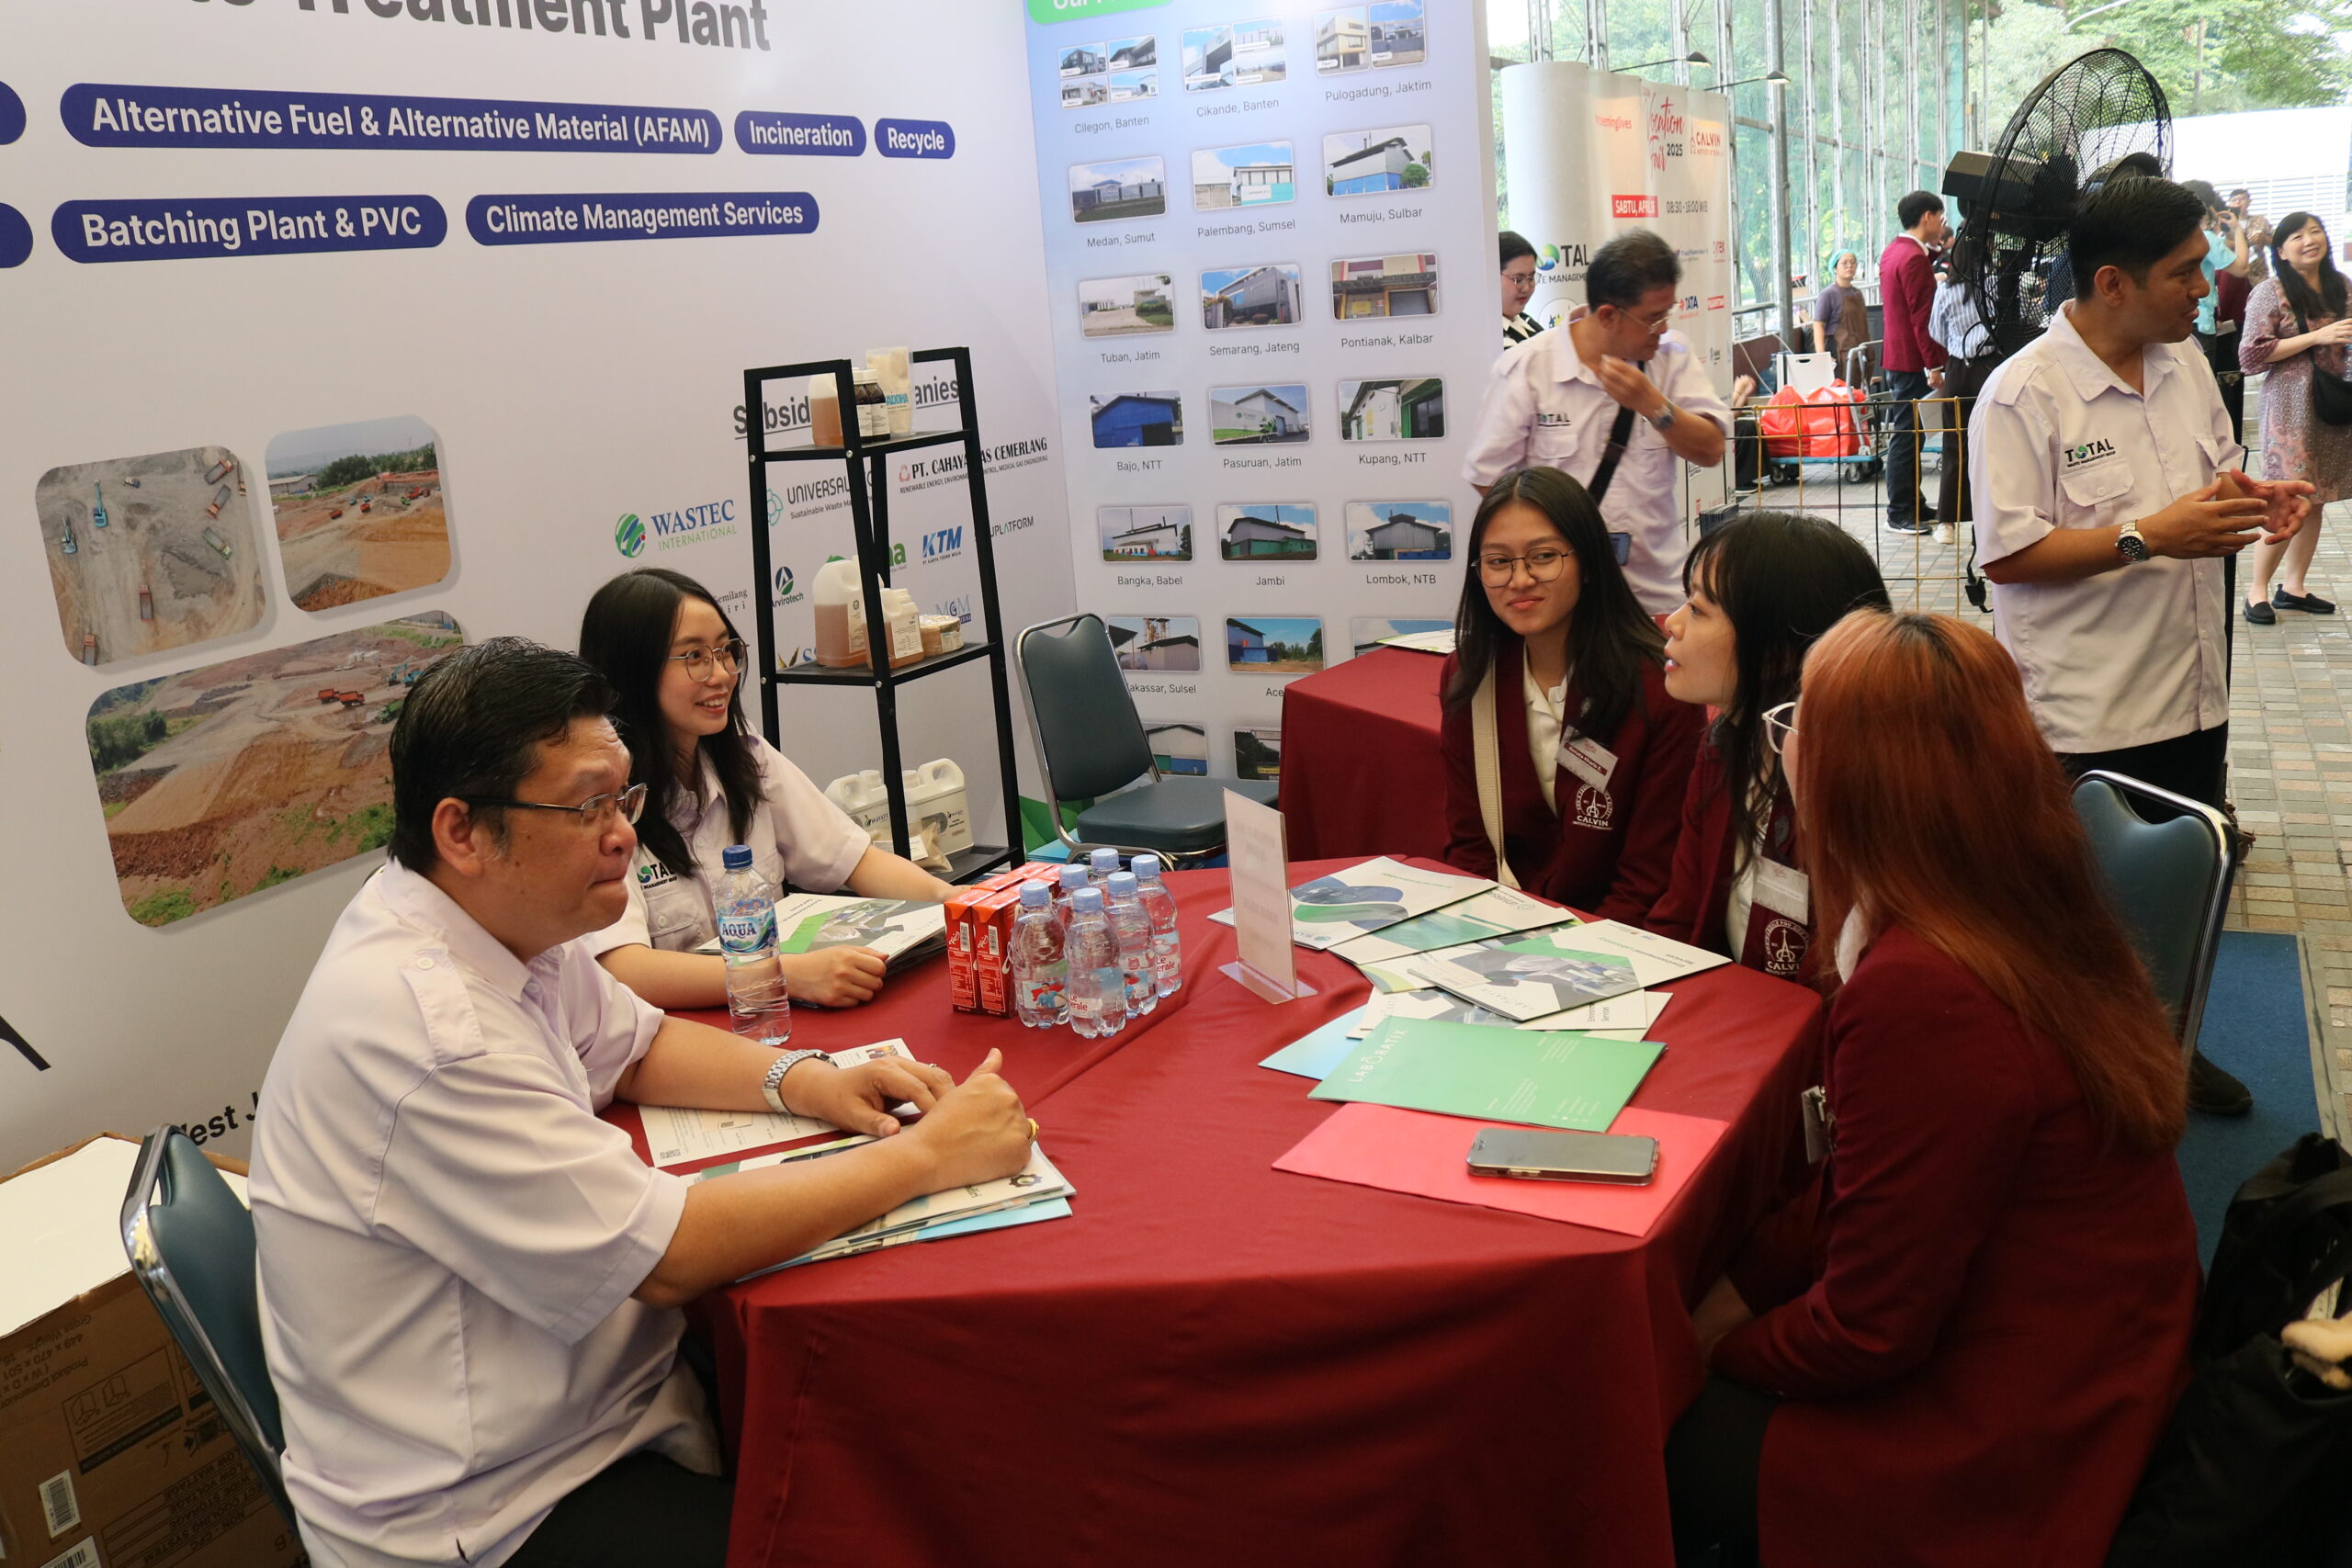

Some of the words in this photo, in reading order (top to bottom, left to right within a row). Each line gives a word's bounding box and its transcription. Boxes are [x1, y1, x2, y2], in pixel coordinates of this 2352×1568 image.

[640, 0, 771, 51] Plant
[1325, 85, 1393, 102] Pulogadung,
[1396, 80, 1432, 93] Jaktim
[1196, 103, 1241, 118] Cikande,
[1243, 98, 1280, 111] Banten
[93, 97, 283, 135] Alternative
[288, 104, 353, 136] Fuel
[360, 107, 381, 136] &
[388, 107, 530, 139] Alternative
[535, 112, 628, 141] Material
[634, 116, 710, 148] (AFAM)
[1074, 122, 1114, 134] Cilegon,
[1115, 116, 1149, 129] Banten
[750, 120, 854, 147] Incineration
[888, 127, 944, 155] Recycle
[1696, 131, 1721, 148] CALVIN
[1667, 143, 1683, 157] 2025
[1615, 199, 1638, 217] SABTU,
[1667, 200, 1682, 213] 08:30
[486, 204, 579, 233] Climate
[582, 201, 720, 235] Management
[723, 200, 803, 226] Services
[1340, 211, 1383, 225] Mamuju,
[1388, 208, 1423, 220] Sulbar
[82, 209, 242, 251] Batching
[246, 209, 329, 241] Plant
[335, 208, 356, 238] &
[360, 206, 422, 236] PVC
[1197, 223, 1256, 238] Palembang,
[1259, 219, 1296, 232] Sumsel
[1087, 235, 1123, 248] Medan,
[1125, 231, 1155, 243] Sumut
[1549, 272, 1588, 284] MANAGEME
[1685, 295, 1699, 310] TATA
[1209, 344, 1263, 356] Semarang,
[1265, 341, 1300, 355] Jateng
[1340, 336, 1396, 349] Pontianak,
[1399, 333, 1434, 345] Kalbar
[1101, 352, 1133, 364] Tuban,
[1135, 350, 1160, 361] Jatim
[912, 461, 929, 479] PT.
[994, 436, 1048, 460] CEMERLANG
[2064, 438, 2115, 462] TOTAL
[1117, 461, 1140, 472] Bajo,
[1142, 460, 1162, 470] NTT
[1223, 457, 1272, 470] Pasuruan,
[1275, 457, 1302, 468] Jatim
[1359, 453, 1402, 467] Kupang,
[1405, 453, 1427, 463] NTT
[786, 475, 851, 505] UNIVERSAL
[899, 482, 926, 494] RENEWABLE
[926, 478, 944, 489] ENERGY,
[650, 499, 735, 537] WASTEC
[790, 506, 824, 520] Sustainable
[825, 502, 842, 512] Waste
[658, 524, 738, 552] INTERNATIONAL
[922, 525, 963, 558] KTM
[1117, 576, 1155, 588] Bangka,
[1157, 575, 1183, 586] Babel
[1256, 575, 1285, 587] Jambi
[1366, 574, 1411, 586] Lombok,
[1414, 574, 1437, 584] NTB
[1169, 683, 1197, 694] Sulsel
[1266, 687, 1283, 696] Ace
[1577, 815, 1609, 827] CALVIN
[637, 862, 676, 884] OTAL
[721, 921, 757, 939] AQUA
[1157, 962, 1175, 972] erale
[1767, 960, 1800, 971] CALVI
[1069, 999, 1088, 1011] erale
[1347, 1030, 1408, 1082] LABORATIX
[181, 1105, 239, 1146] est
[63, 1333, 84, 1348] 449
[33, 1348, 53, 1365] 470
[51, 1357, 89, 1382] Product
[217, 1447, 242, 1471] LOW
[220, 1461, 243, 1484] LOW
[164, 1464, 216, 1501] WATTAGE
[222, 1474, 251, 1498] WIDE
[169, 1479, 219, 1514] VOLTAGE
[169, 1493, 222, 1532] STORAGE
[191, 1496, 241, 1534] COOLING
[221, 1509, 245, 1530] NON
[143, 1530, 189, 1562] SYSTEM
[190, 1531, 213, 1551] CFC
